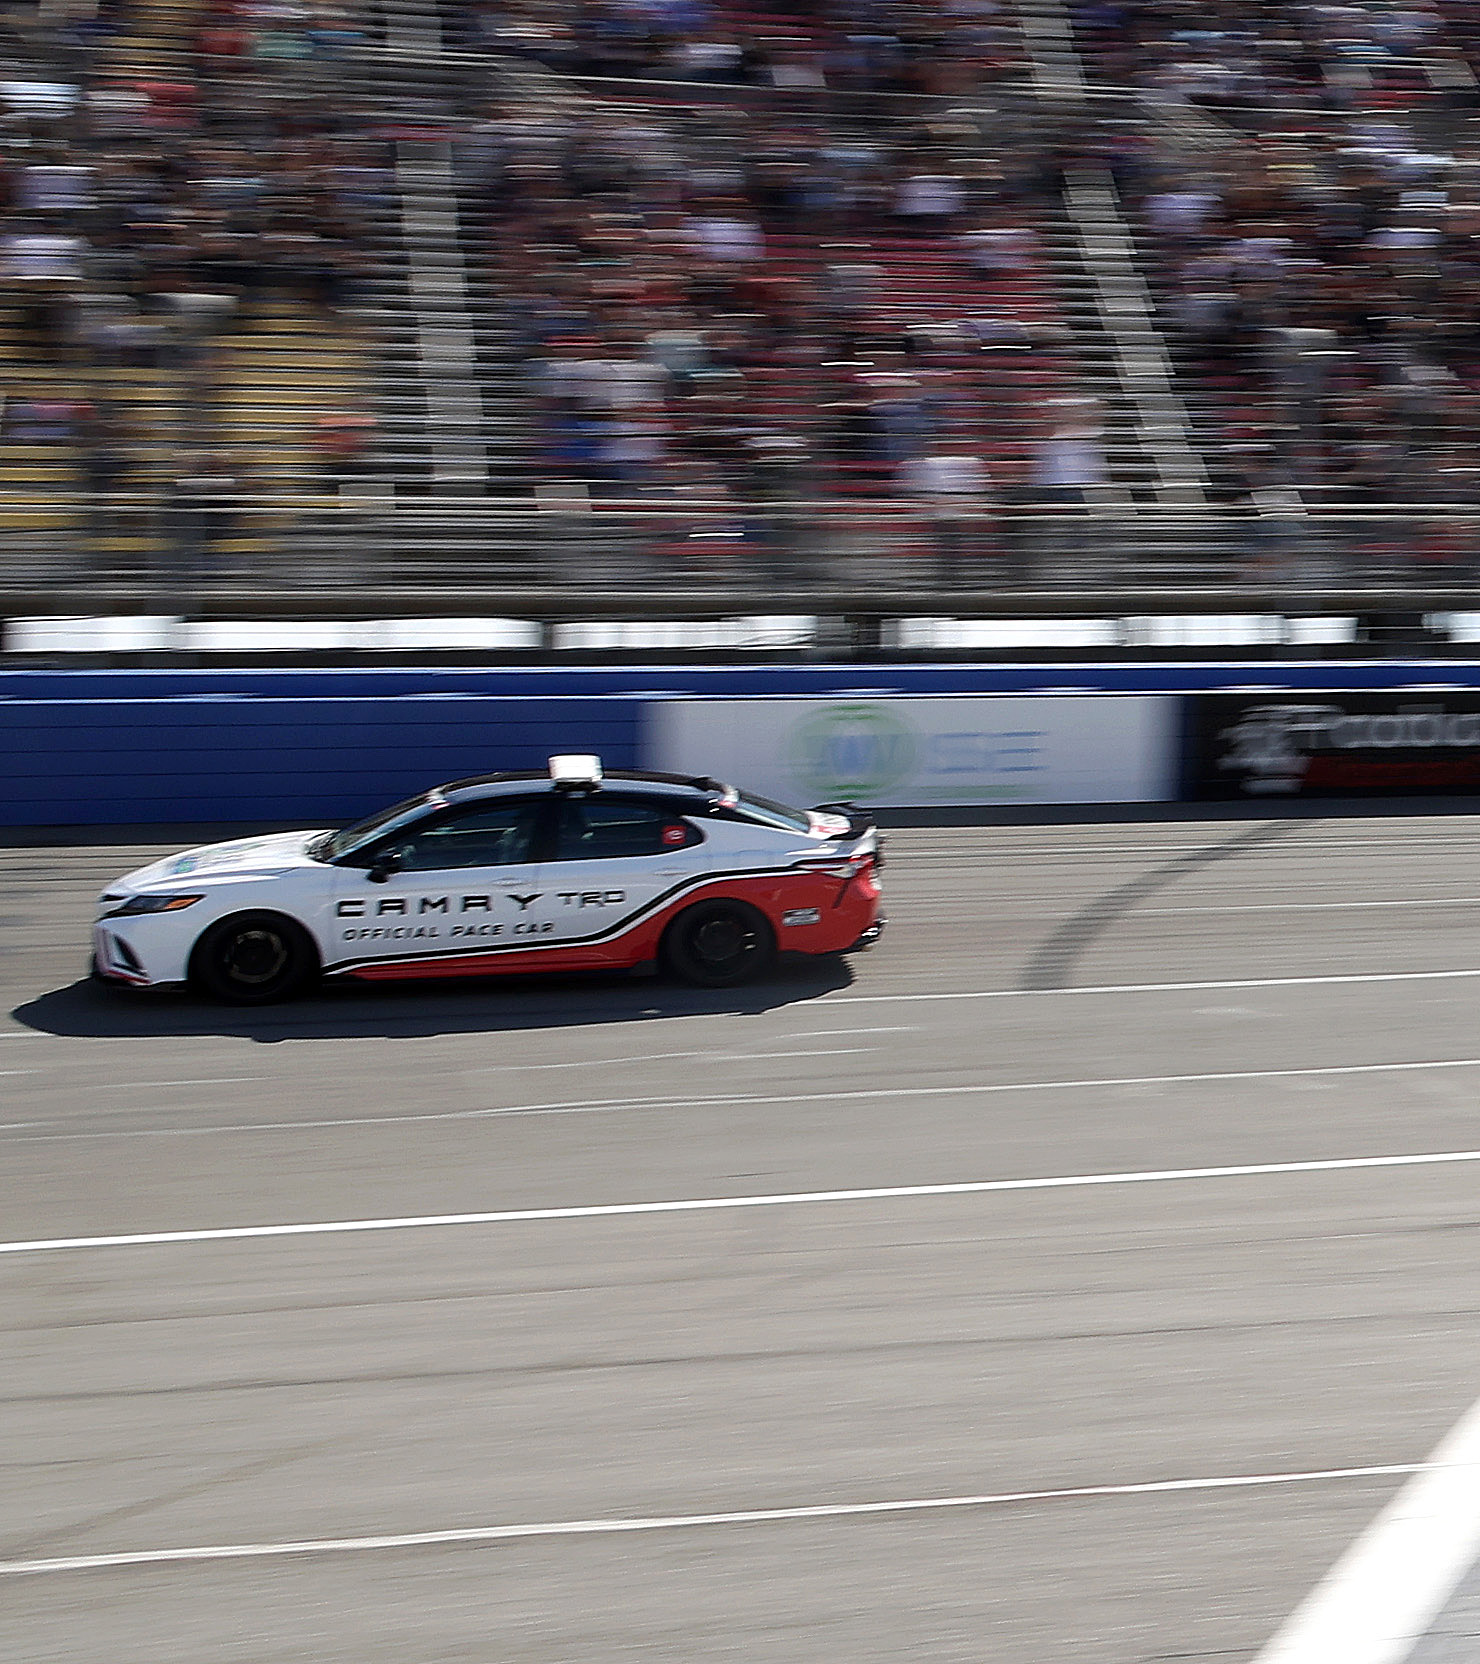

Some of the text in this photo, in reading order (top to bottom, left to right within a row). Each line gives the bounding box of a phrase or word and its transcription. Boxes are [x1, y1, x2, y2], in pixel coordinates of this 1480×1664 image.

[336, 890, 626, 918] CAMRY TRD
[343, 922, 555, 942] OFFICIAL PACE CAR
